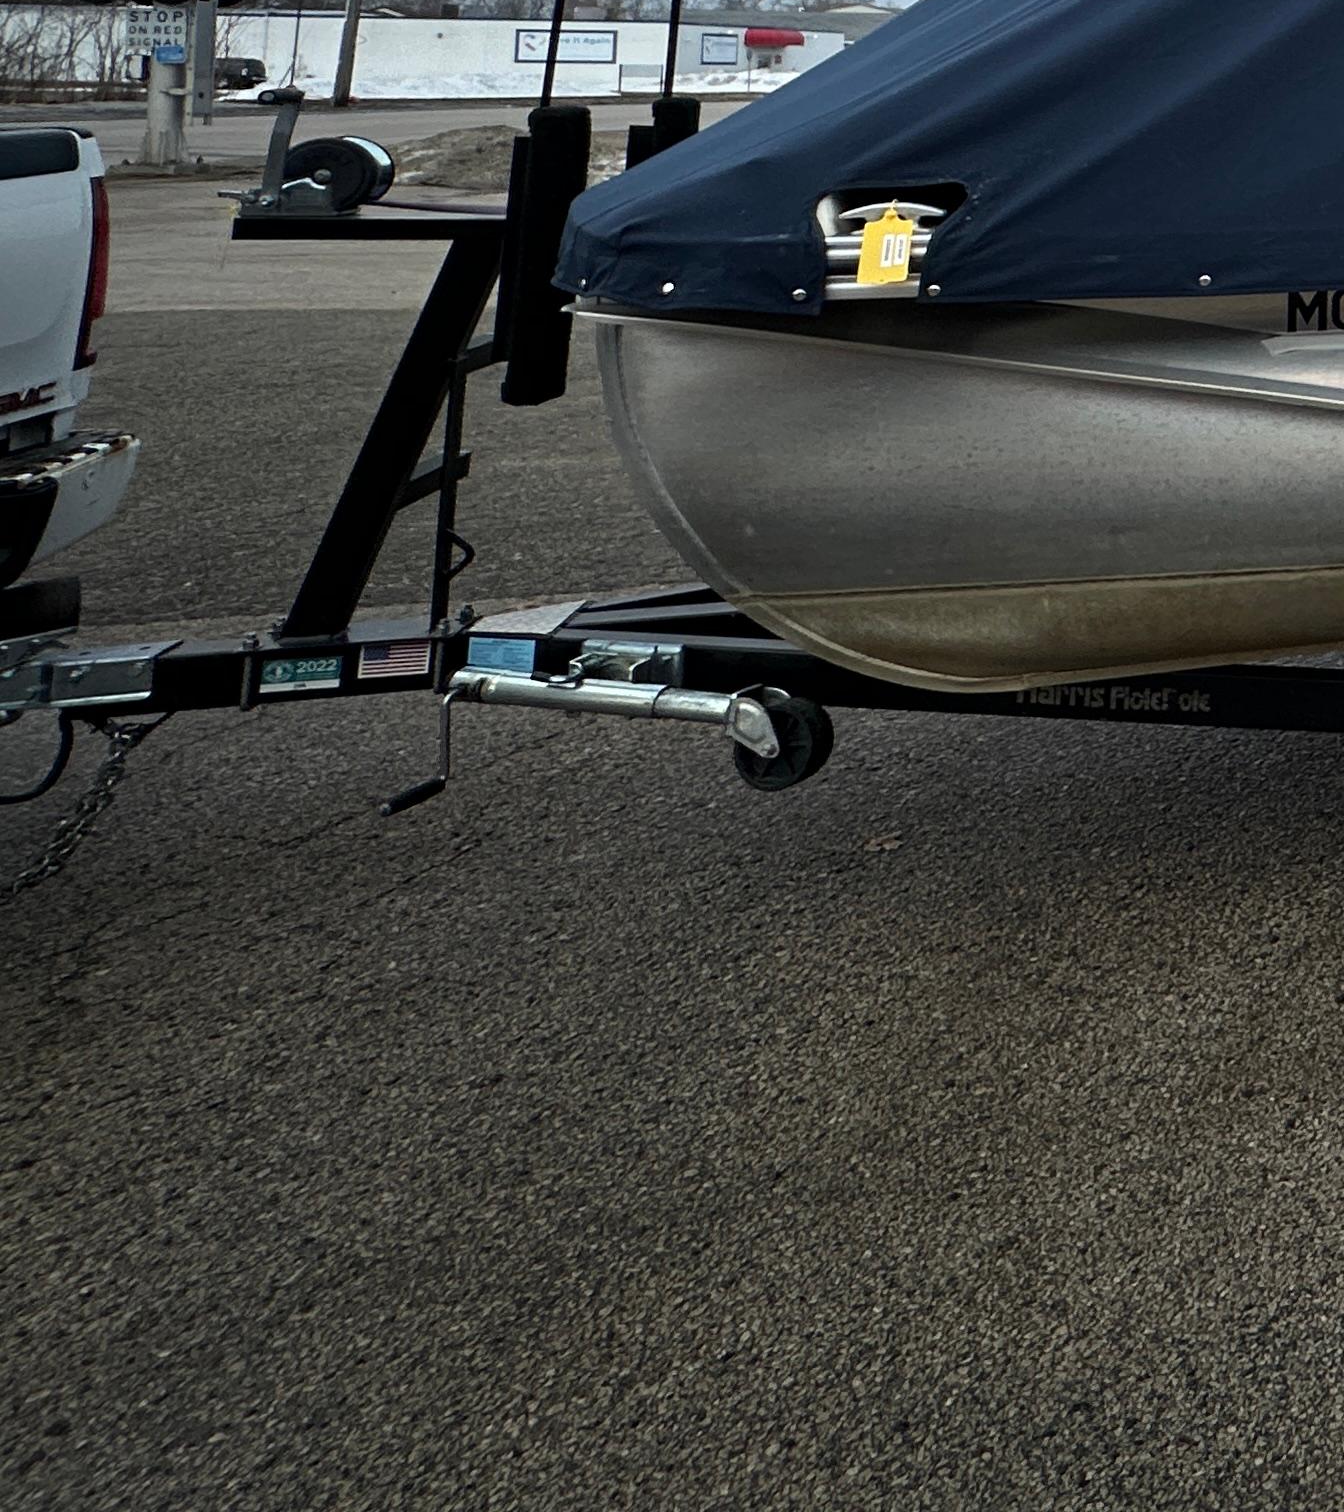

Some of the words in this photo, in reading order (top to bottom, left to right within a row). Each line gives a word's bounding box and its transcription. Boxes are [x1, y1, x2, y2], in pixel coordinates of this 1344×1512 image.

[129, 10, 184, 23] STOP
[128, 25, 148, 35] ON
[153, 25, 182, 35] RED
[128, 37, 179, 47] SIGNAL
[295, 659, 337, 673] 2022
